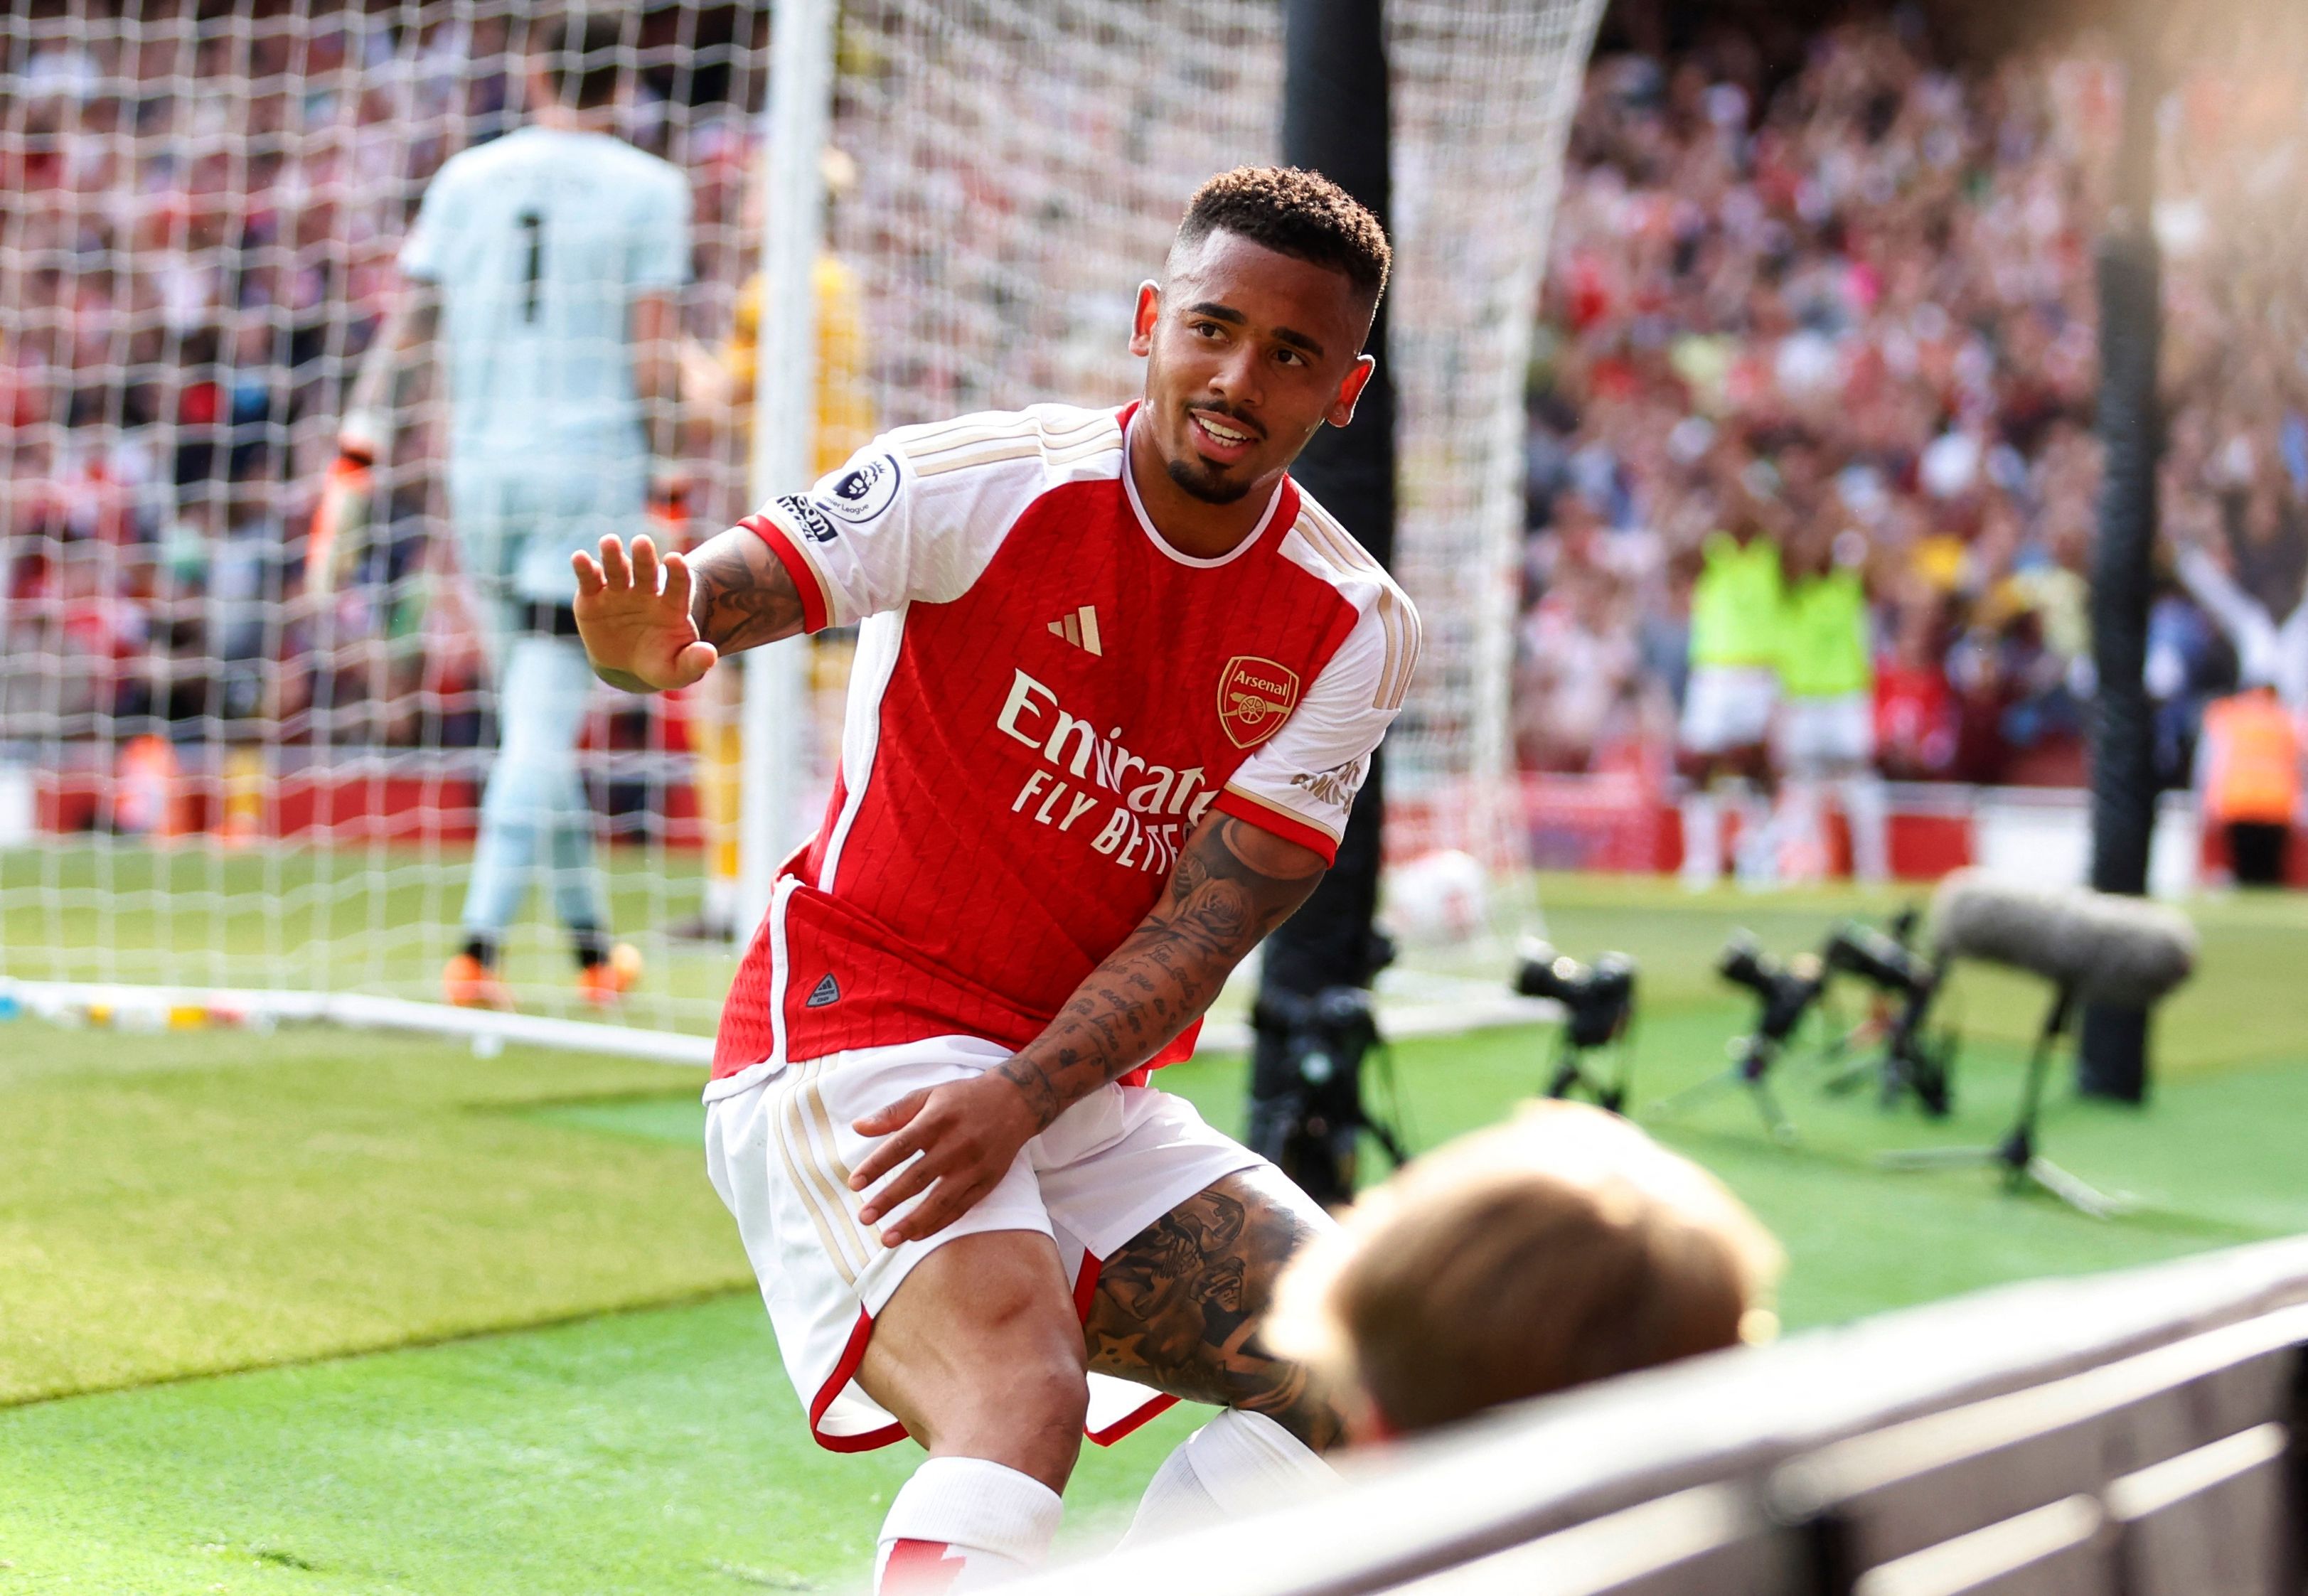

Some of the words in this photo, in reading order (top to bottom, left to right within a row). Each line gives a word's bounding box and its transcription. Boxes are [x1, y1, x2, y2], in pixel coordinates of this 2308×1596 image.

[515, 208, 541, 324] 1
[796, 496, 829, 535] oom
[823, 496, 841, 508] mier
[841, 503, 869, 515] League
[1234, 670, 1288, 697] Arsenal
[997, 668, 1220, 828] Emirate
[1011, 769, 1098, 831] FLY
